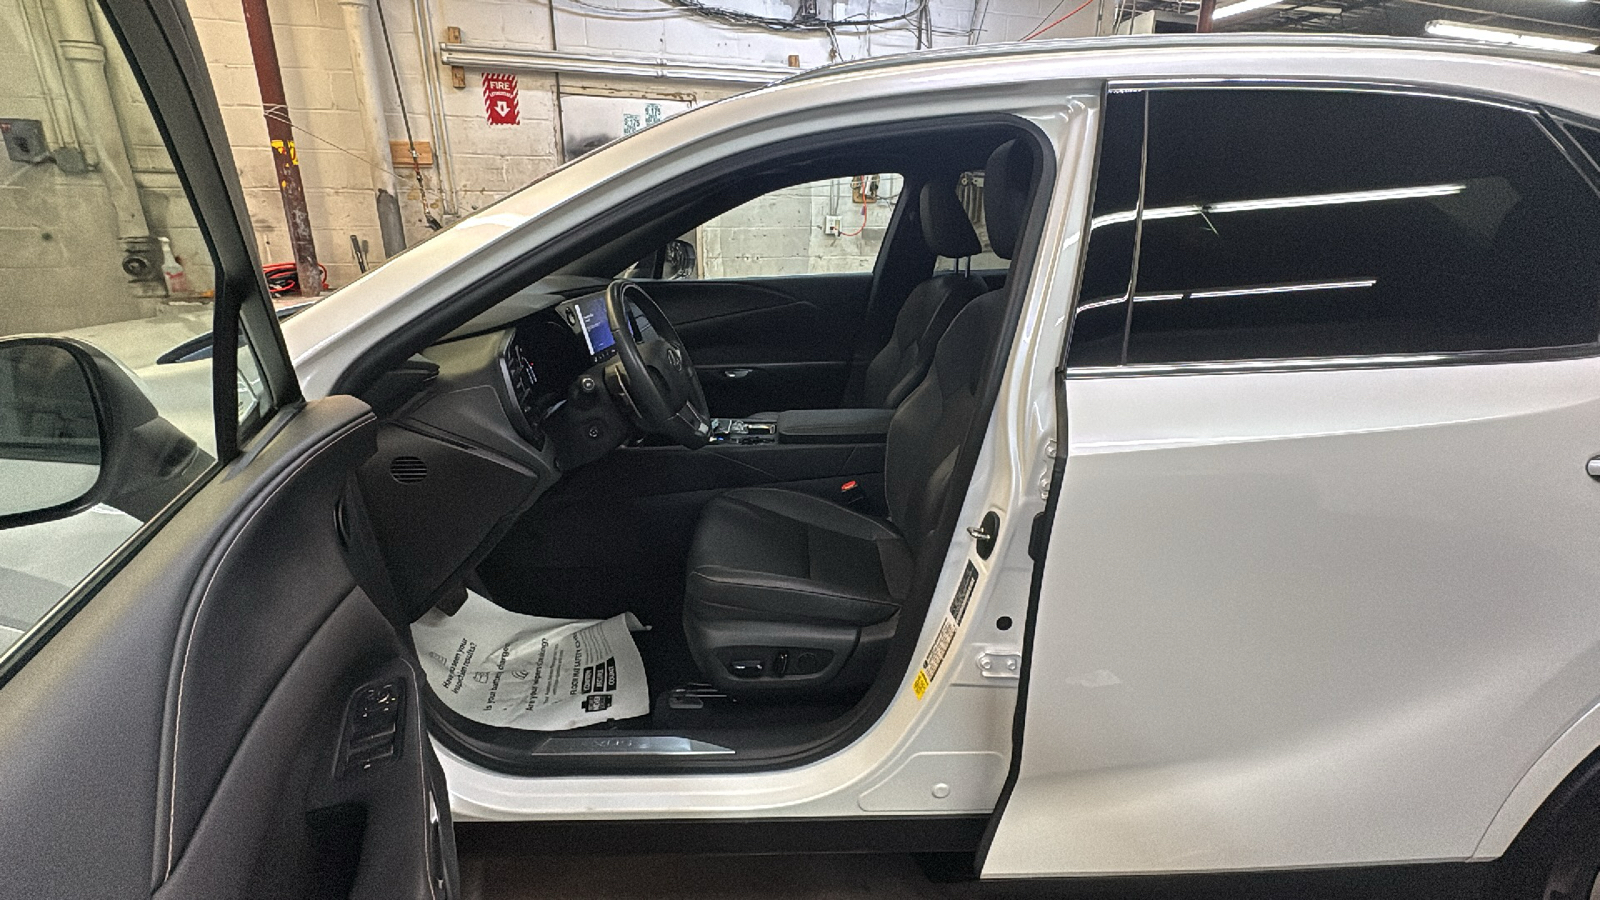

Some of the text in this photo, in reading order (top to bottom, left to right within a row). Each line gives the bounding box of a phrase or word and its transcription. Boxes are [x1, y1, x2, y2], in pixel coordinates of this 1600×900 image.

[490, 81, 511, 90] FIRE
[452, 652, 461, 667] seen
[457, 638, 467, 654] your
[463, 641, 477, 667] results?
[574, 649, 583, 667] SAFETY
[570, 678, 580, 695] FLOOR
[487, 691, 496, 703] your
